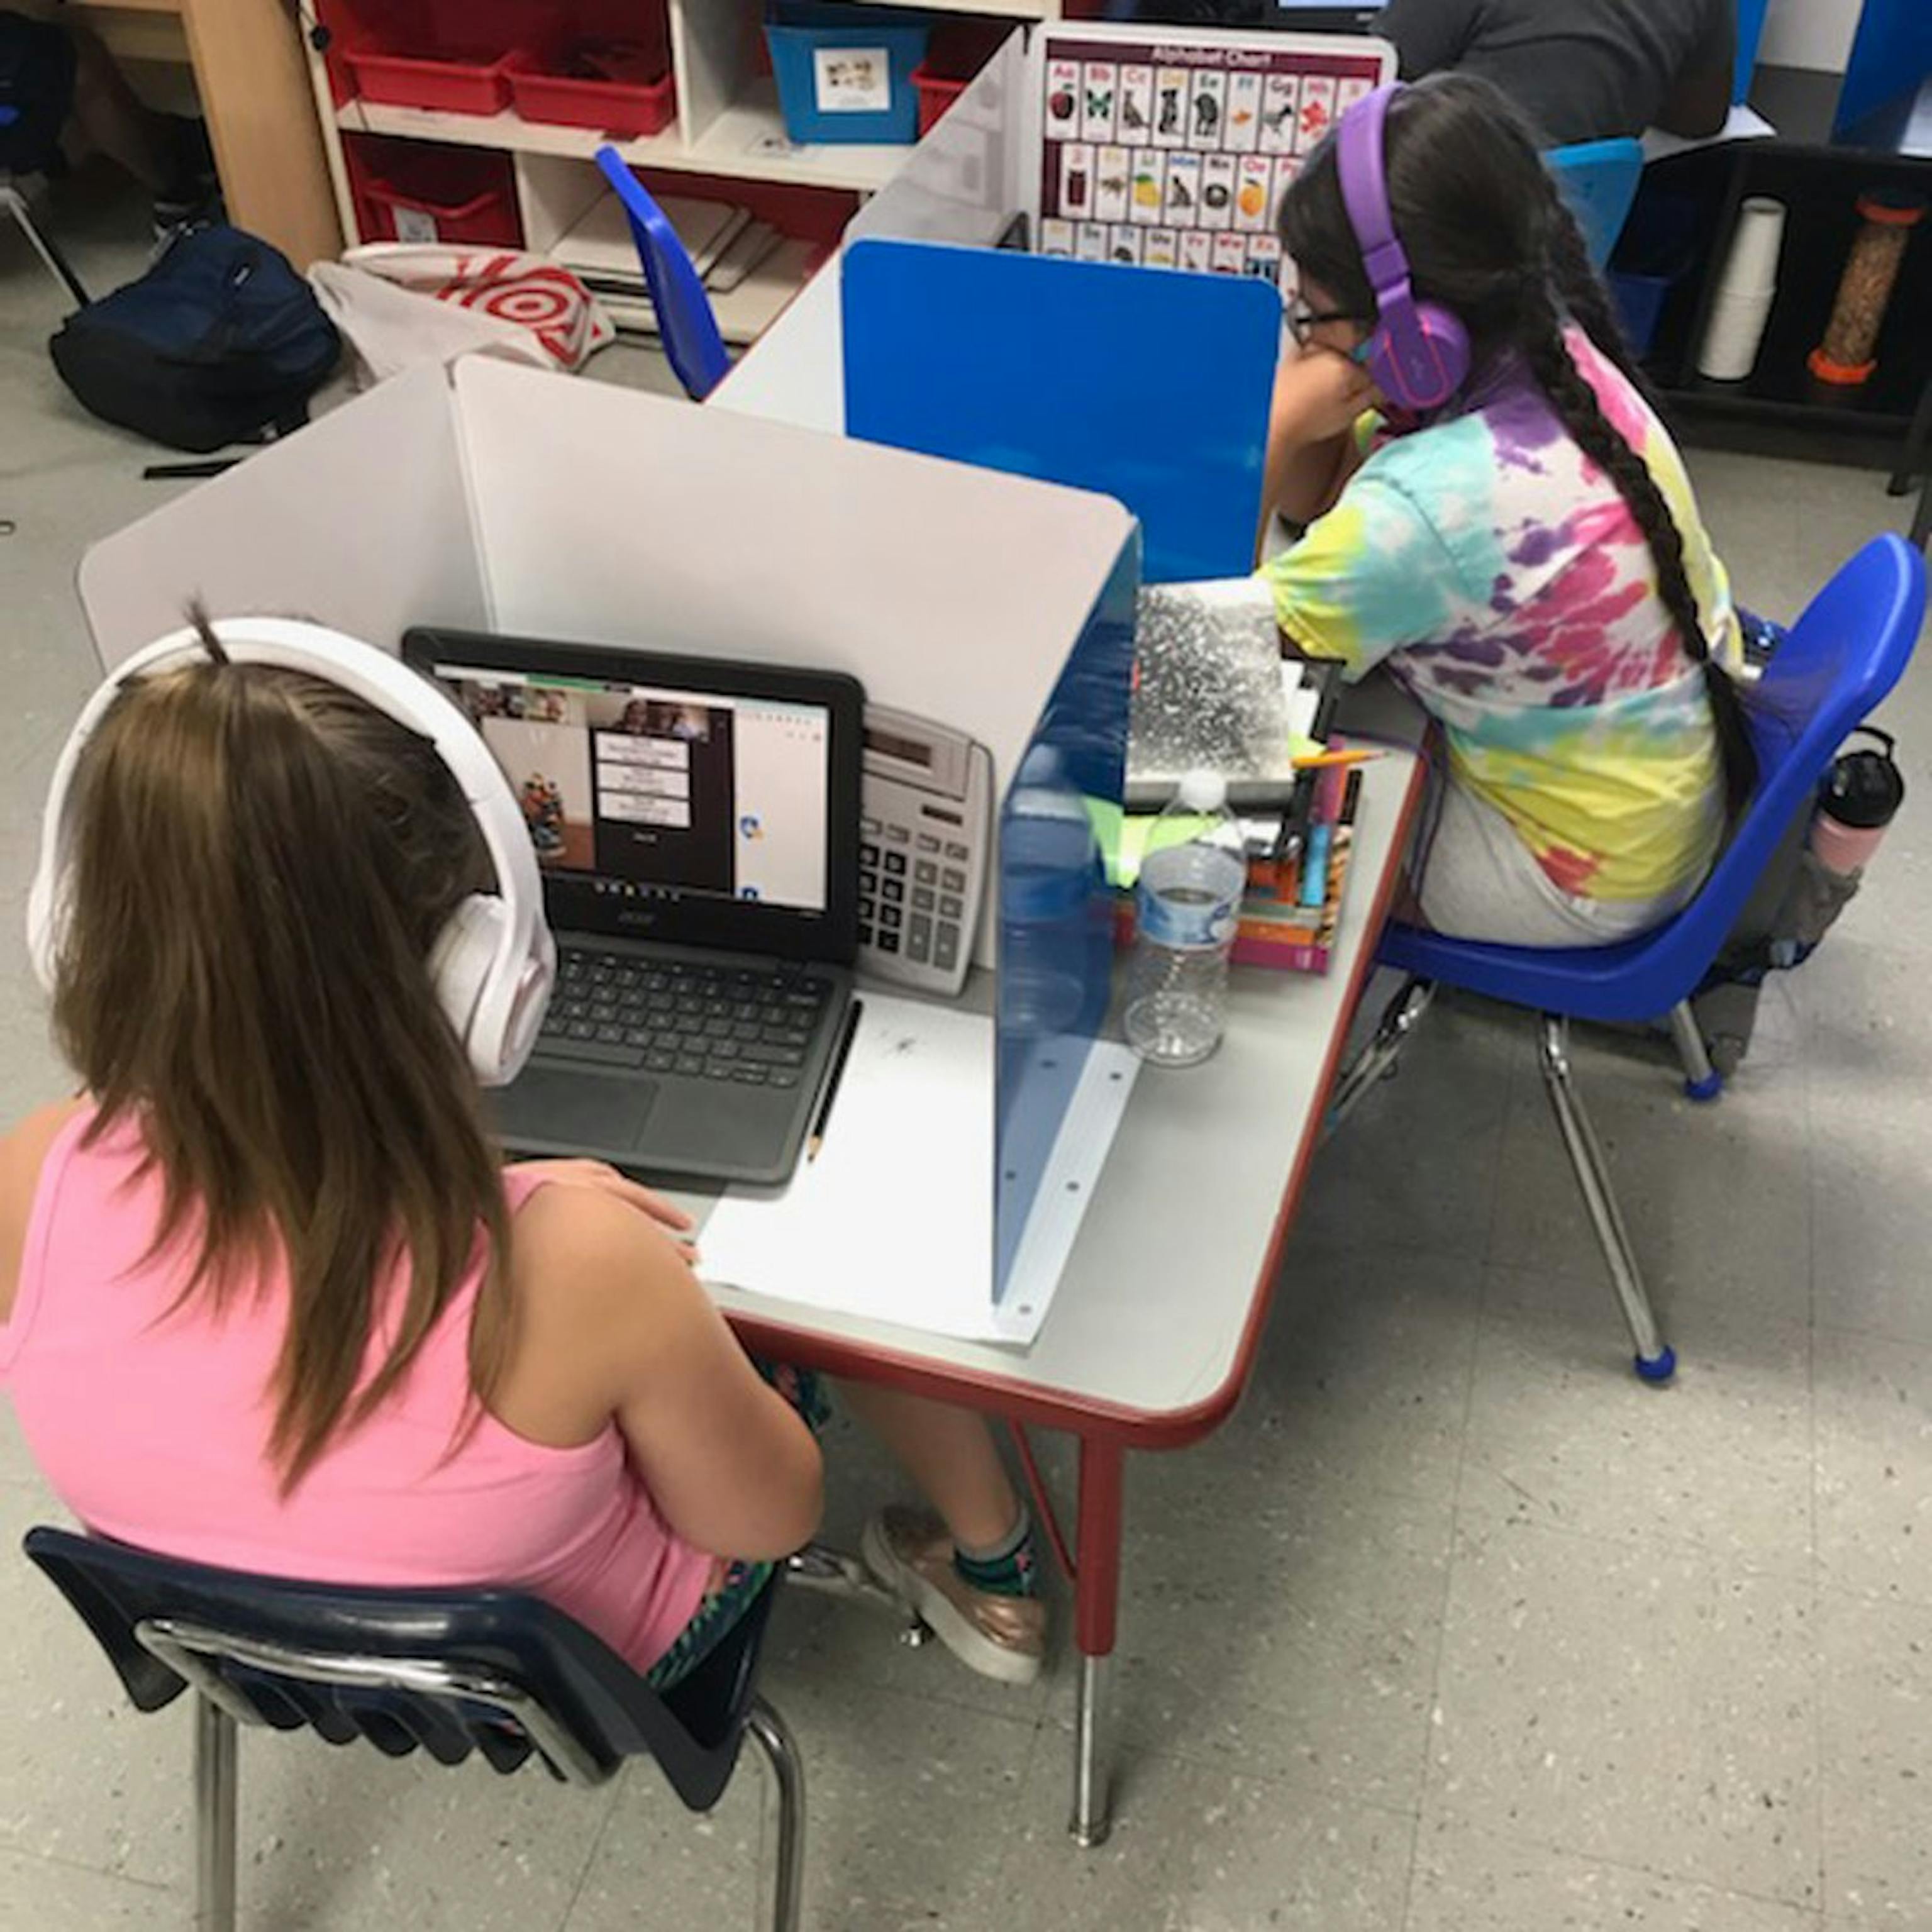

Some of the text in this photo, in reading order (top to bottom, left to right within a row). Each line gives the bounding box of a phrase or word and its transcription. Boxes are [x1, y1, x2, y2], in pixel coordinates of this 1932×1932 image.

[1152, 47, 1271, 67] Alphabet Chart
[1270, 77, 1293, 96] Gg
